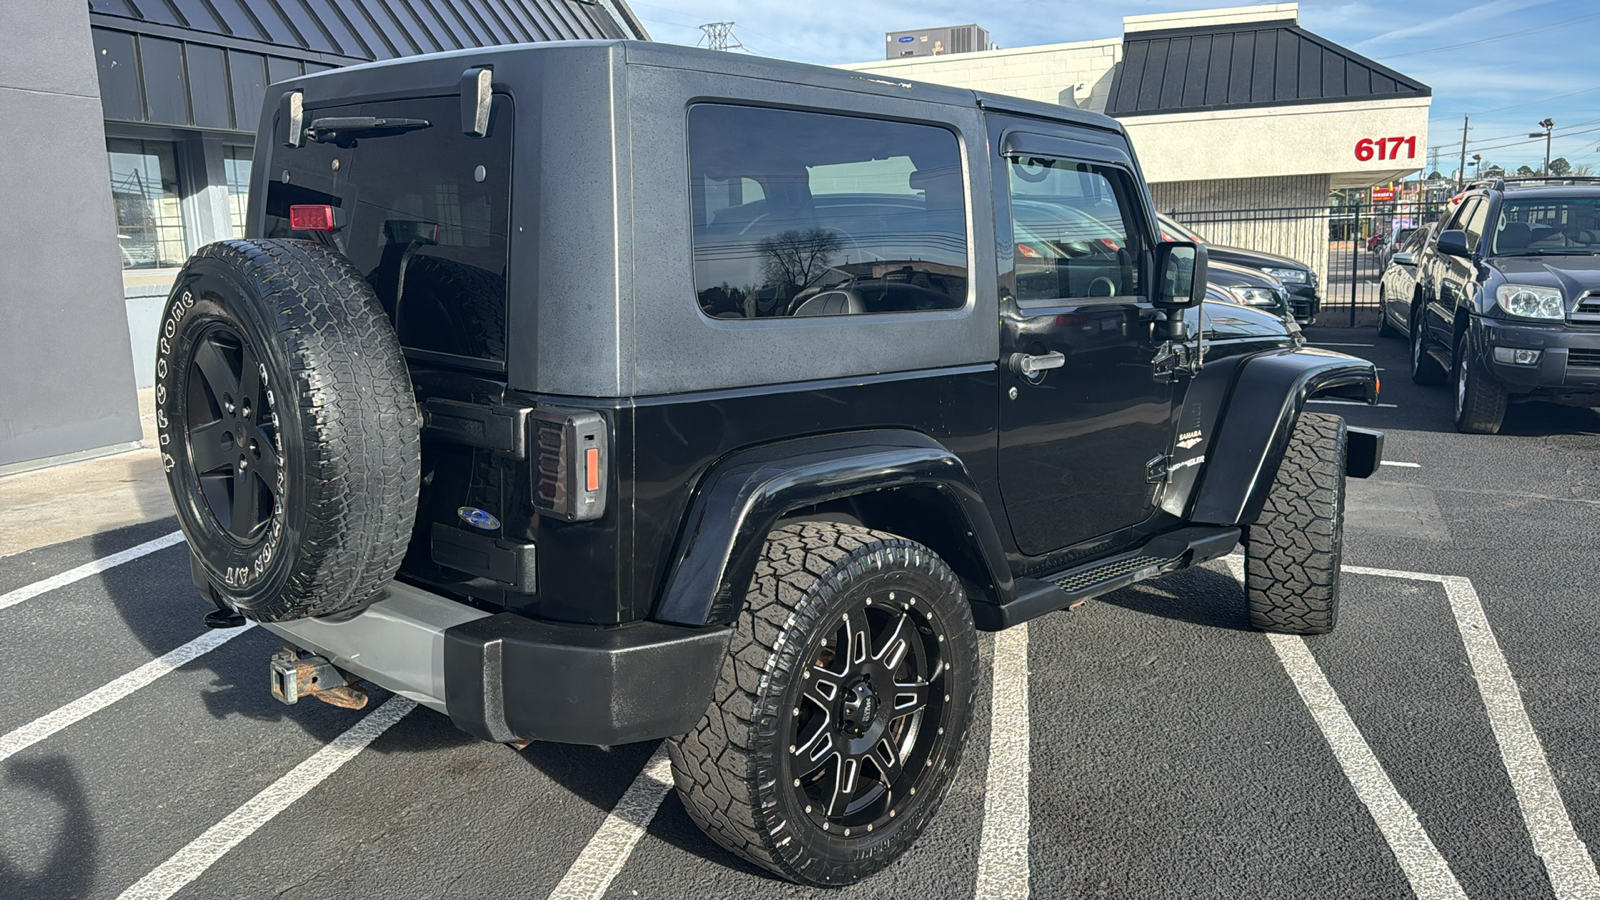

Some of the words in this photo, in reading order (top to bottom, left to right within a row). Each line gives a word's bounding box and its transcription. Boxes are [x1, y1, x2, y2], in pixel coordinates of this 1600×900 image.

[1354, 135, 1417, 162] 6171
[156, 290, 195, 473] Firestone
[1179, 430, 1202, 441] SAHARA
[225, 566, 249, 587] A/T
